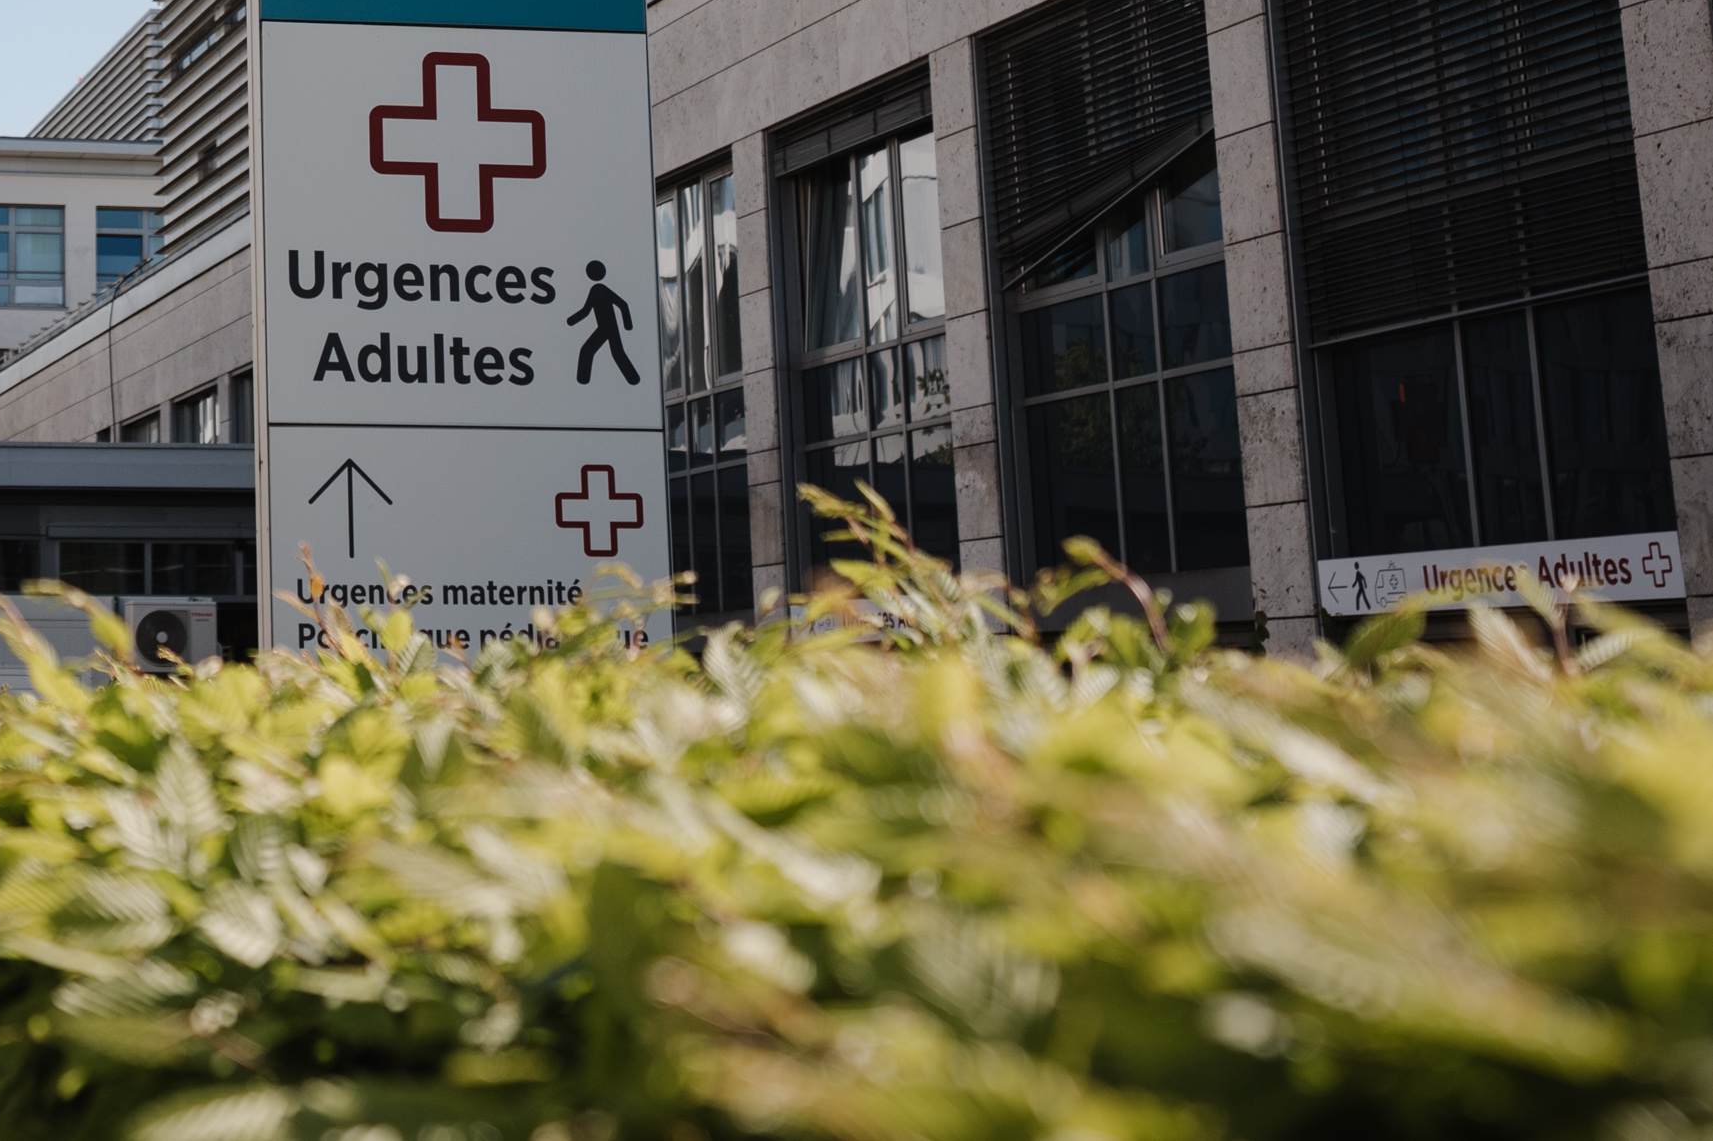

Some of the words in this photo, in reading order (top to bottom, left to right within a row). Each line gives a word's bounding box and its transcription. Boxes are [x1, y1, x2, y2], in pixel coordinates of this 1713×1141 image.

[288, 249, 557, 311] Urgences
[313, 332, 535, 386] Adultes
[297, 578, 434, 608] Urgences
[442, 579, 583, 606] maternité
[1538, 551, 1632, 589] Adultes
